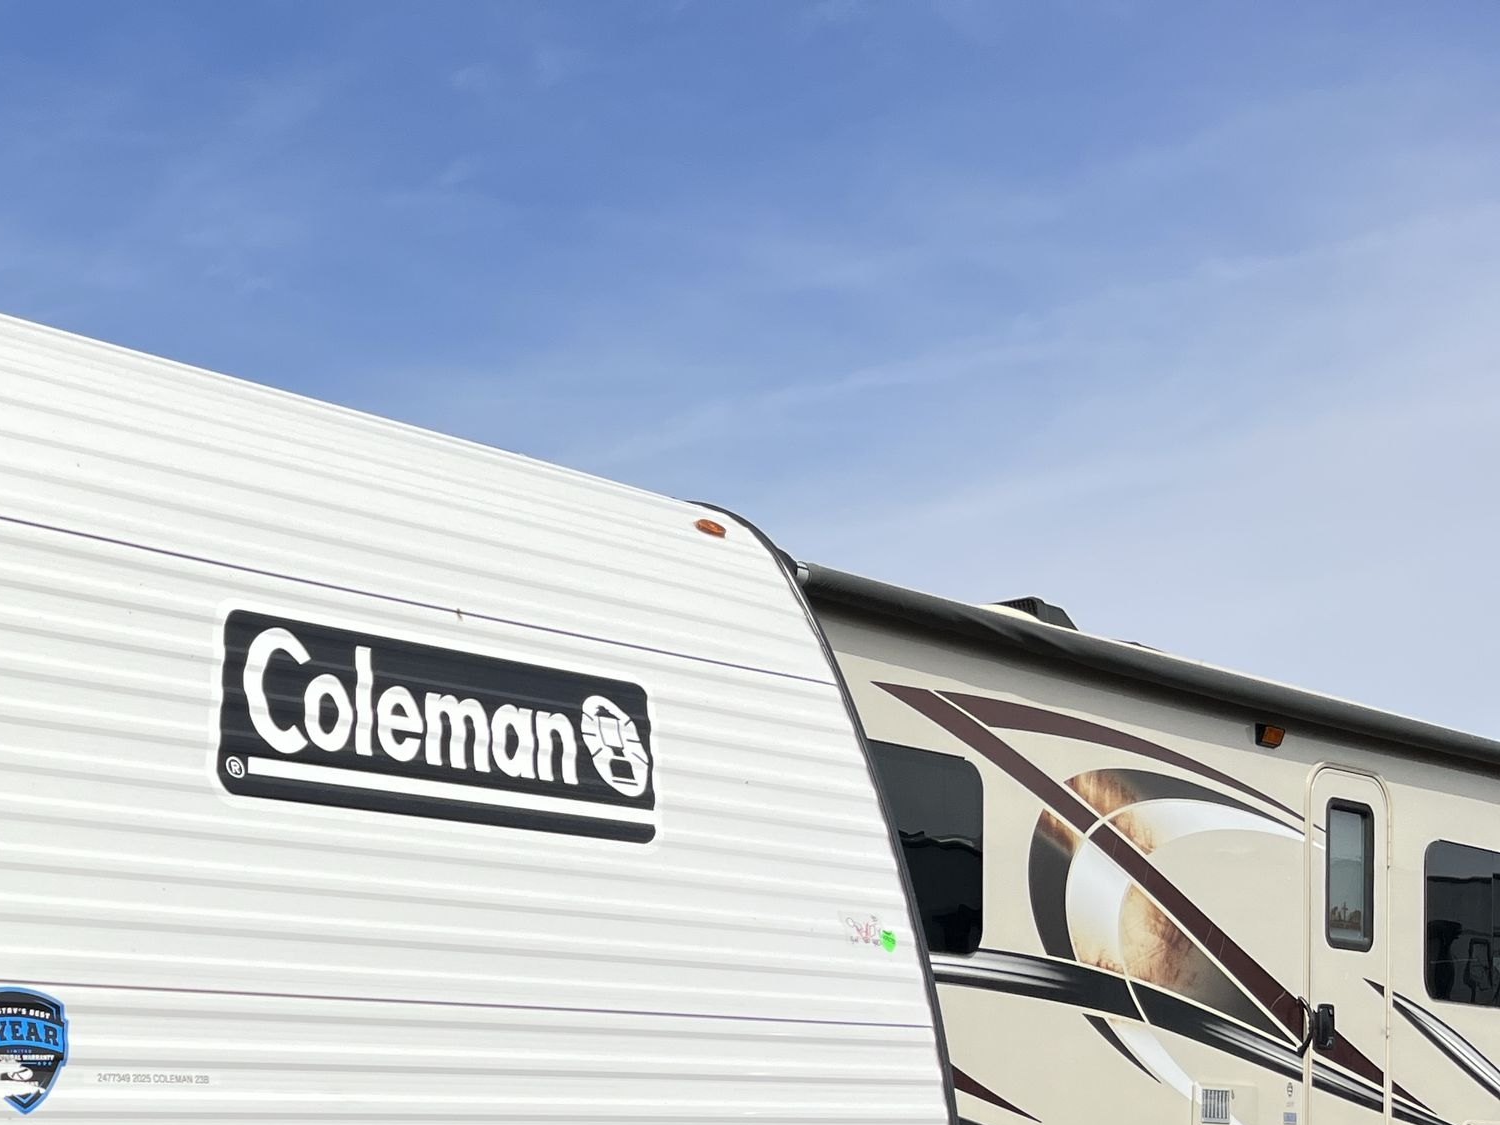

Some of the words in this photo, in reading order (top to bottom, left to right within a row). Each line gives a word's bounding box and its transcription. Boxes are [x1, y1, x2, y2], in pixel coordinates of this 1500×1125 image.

[243, 626, 579, 785] Coleman
[29, 1008, 51, 1020] BEST
[132, 1073, 152, 1083] 2025
[152, 1073, 193, 1084] COLEMAN
